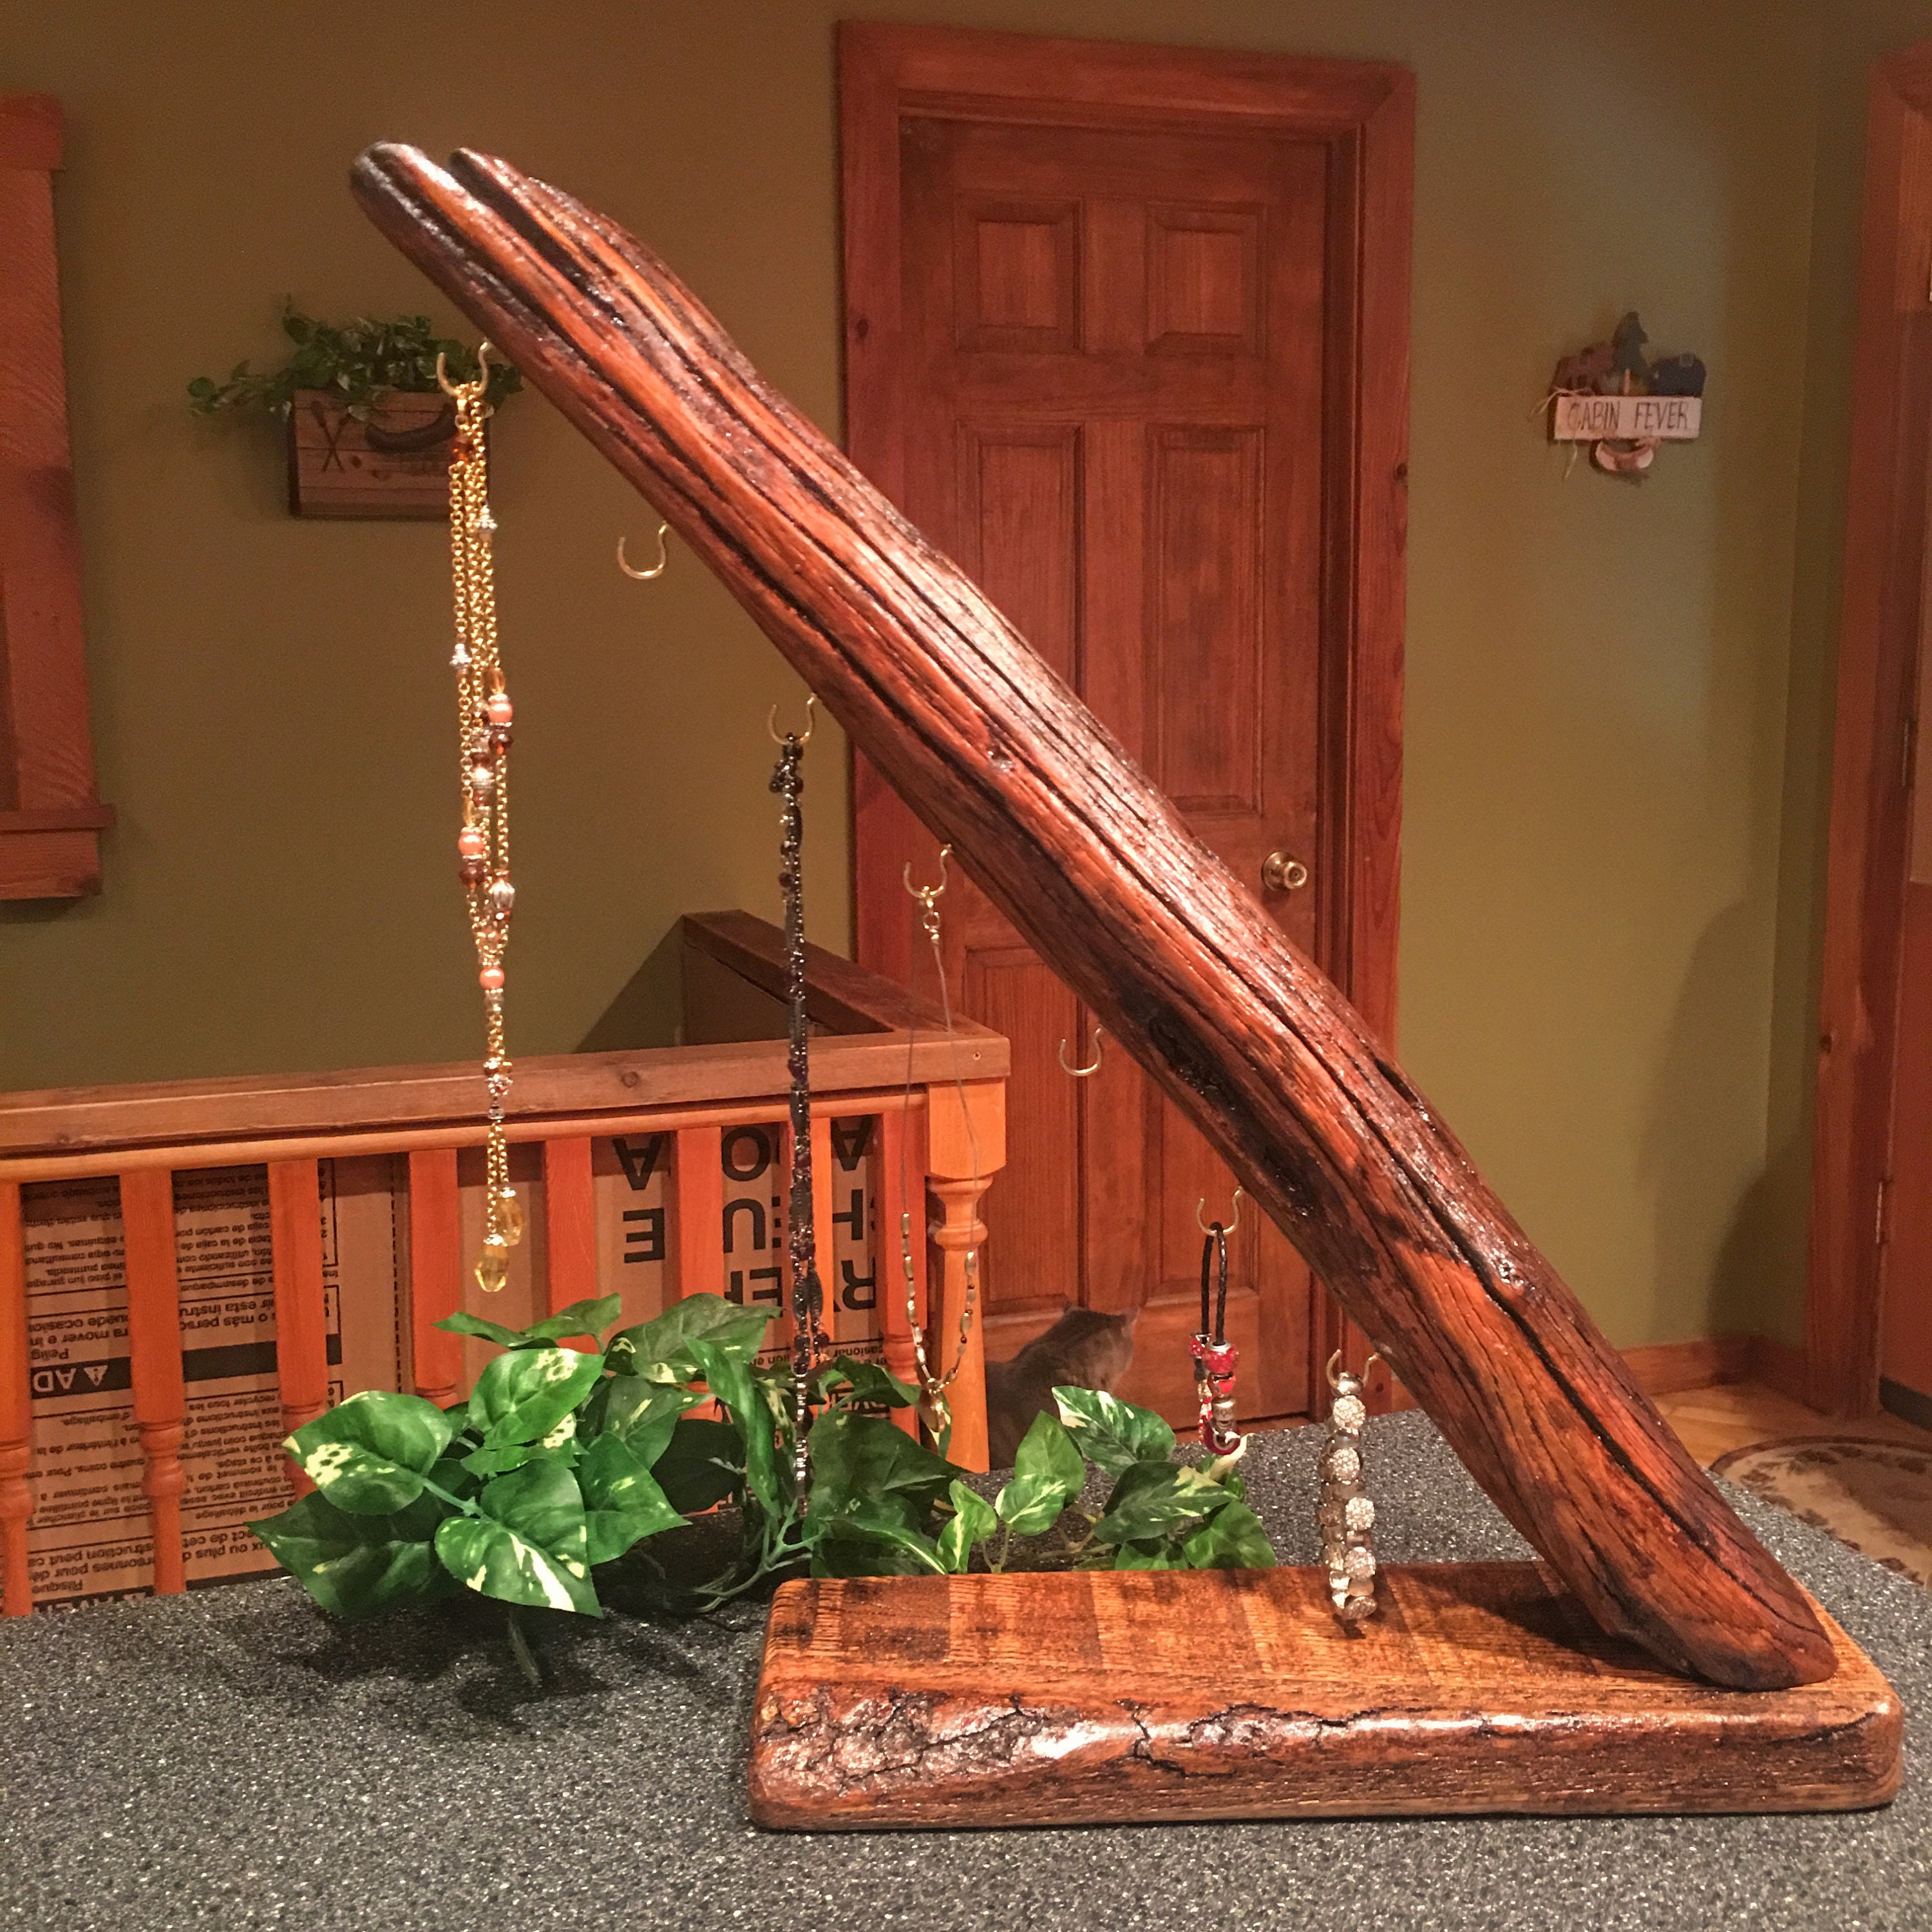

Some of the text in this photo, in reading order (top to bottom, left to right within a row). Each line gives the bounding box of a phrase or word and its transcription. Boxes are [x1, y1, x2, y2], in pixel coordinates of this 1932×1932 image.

[1567, 400, 1689, 431] CABIN FEVER
[196, 1545, 225, 1560] plus
[53, 1563, 88, 1578] pour
[92, 1557, 155, 1573] ersonnes
